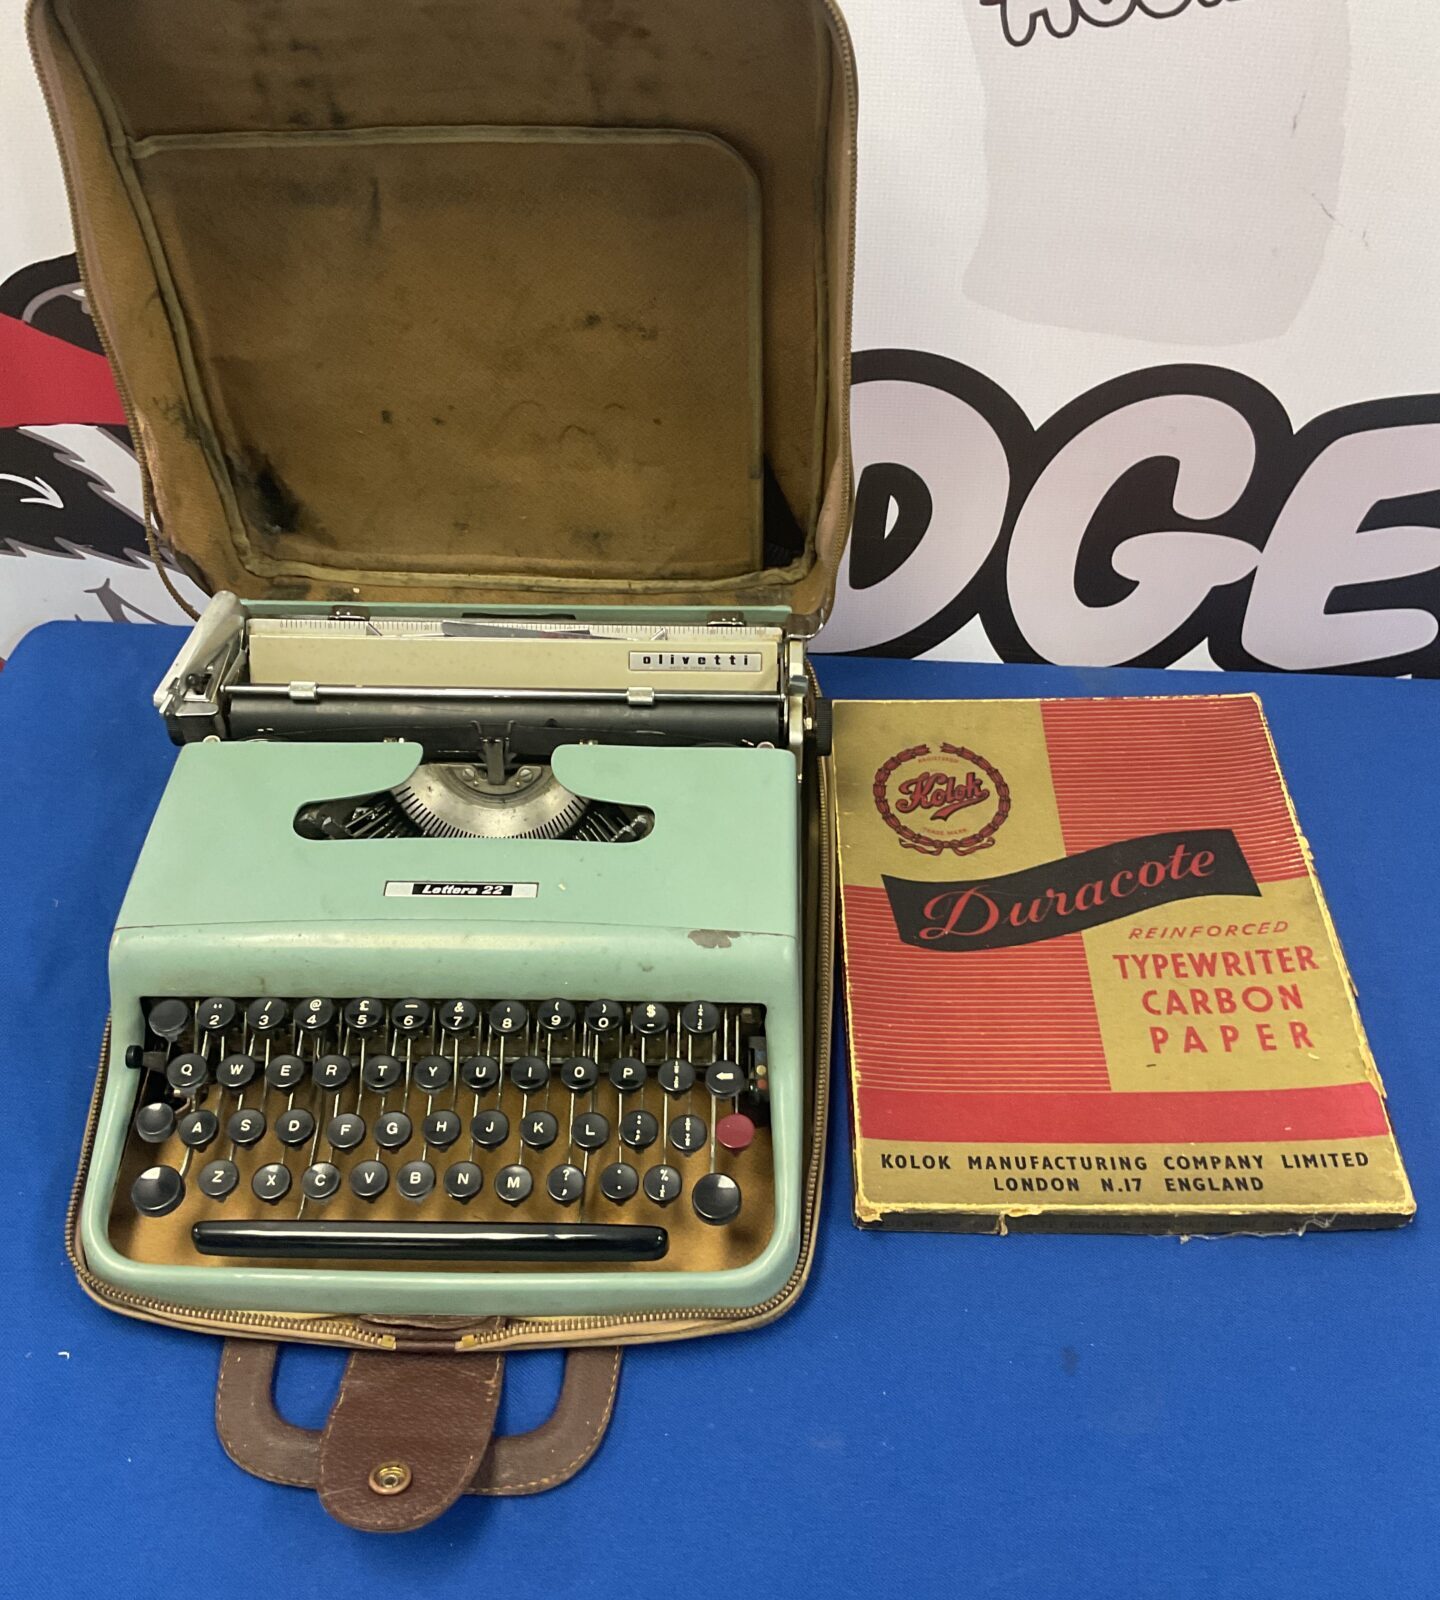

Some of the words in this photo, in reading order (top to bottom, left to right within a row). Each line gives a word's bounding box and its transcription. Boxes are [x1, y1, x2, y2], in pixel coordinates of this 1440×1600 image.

[642, 653, 749, 666] olivetti
[895, 771, 990, 822] Kolok
[422, 884, 479, 896] Lettera
[481, 885, 504, 896] 22
[918, 842, 1216, 941] Duracote
[1128, 920, 1289, 940] REINFORCED
[1112, 945, 1320, 980] TYPEWRITER
[310, 999, 321, 1011] @
[1141, 983, 1304, 1016] CARBON
[360, 1001, 369, 1011] £
[455, 1002, 464, 1012] &
[647, 1005, 656, 1017] $
[209, 1014, 220, 1026] 2
[258, 1014, 269, 1026] 3
[307, 1014, 317, 1025] 4
[356, 1014, 367, 1025] 5
[403, 1015, 413, 1026] 6
[453, 1015, 462, 1026] 7
[502, 1017, 512, 1029] 8
[551, 1015, 561, 1026] 9
[598, 1018, 609, 1028] 0
[1149, 1021, 1315, 1054] PAPER
[181, 1064, 192, 1076] Q
[231, 1065, 243, 1074] W
[281, 1065, 291, 1076] E
[326, 1065, 337, 1075] R
[378, 1065, 388, 1076] T
[428, 1066, 438, 1077] Y
[476, 1067, 486, 1077] U
[575, 1067, 584, 1077] O
[623, 1068, 633, 1078] P
[192, 1122, 201, 1132] A
[241, 1119, 251, 1131] S
[289, 1120, 299, 1131] D
[341, 1125, 350, 1135] F
[387, 1122, 398, 1134] G
[437, 1121, 447, 1131] H
[485, 1121, 494, 1133] J
[534, 1122, 543, 1132] K
[586, 1125, 595, 1135] L
[881, 1153, 951, 1170] KOLOK
[967, 1155, 1148, 1171] MANUFACTURING
[1163, 1154, 1263, 1171] COMPANY
[1281, 1152, 1369, 1169] LIMITED
[212, 1171, 224, 1182] Z
[267, 1175, 276, 1185] X
[315, 1174, 326, 1186] C
[365, 1172, 374, 1183] V
[410, 1172, 421, 1184] B
[458, 1173, 469, 1184] N
[563, 1168, 571, 1181] ?
[659, 1168, 669, 1182] %
[508, 1177, 520, 1188] M
[993, 1177, 1080, 1192] LONDON
[1101, 1177, 1142, 1193] N.17
[1164, 1176, 1264, 1192] ENGLAND
